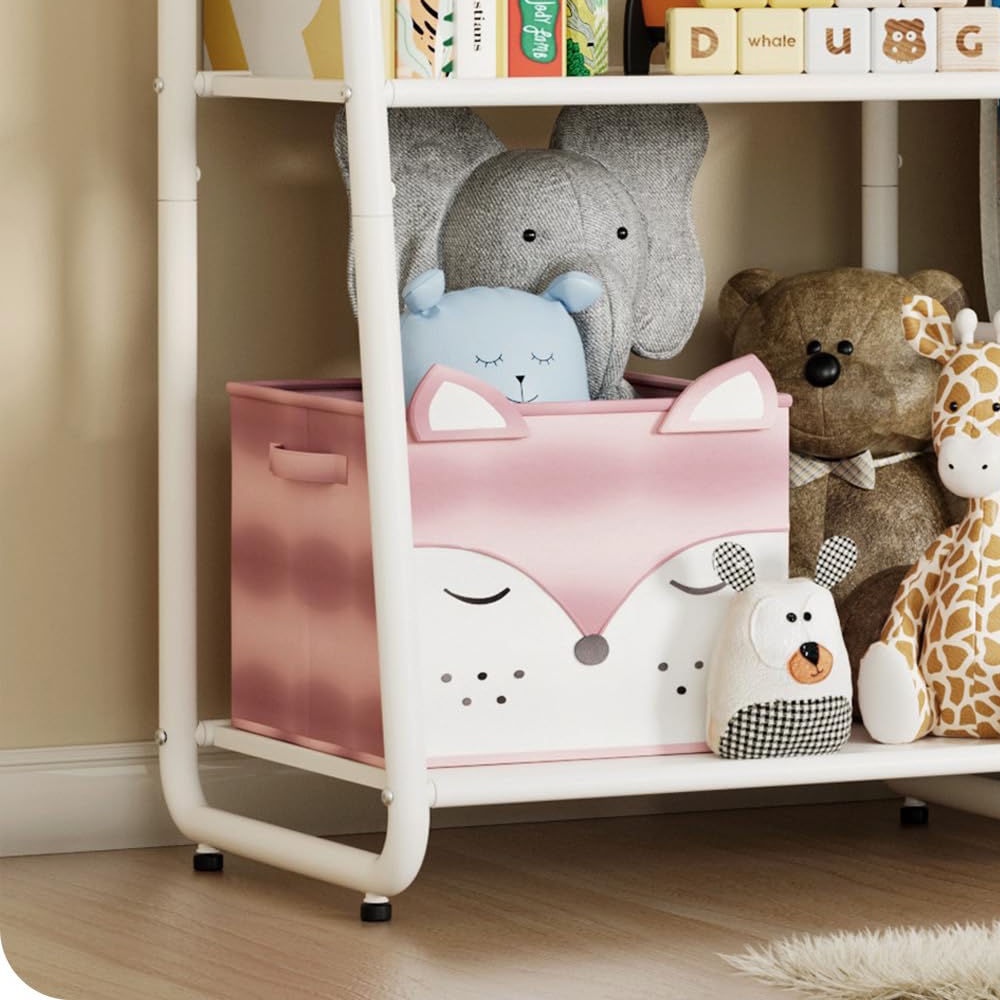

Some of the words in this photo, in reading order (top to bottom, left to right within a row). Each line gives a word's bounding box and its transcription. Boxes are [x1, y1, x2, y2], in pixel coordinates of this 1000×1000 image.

[690, 26, 720, 59] D
[747, 34, 797, 48] whale
[825, 27, 851, 56] u
[955, 24, 983, 58] G
